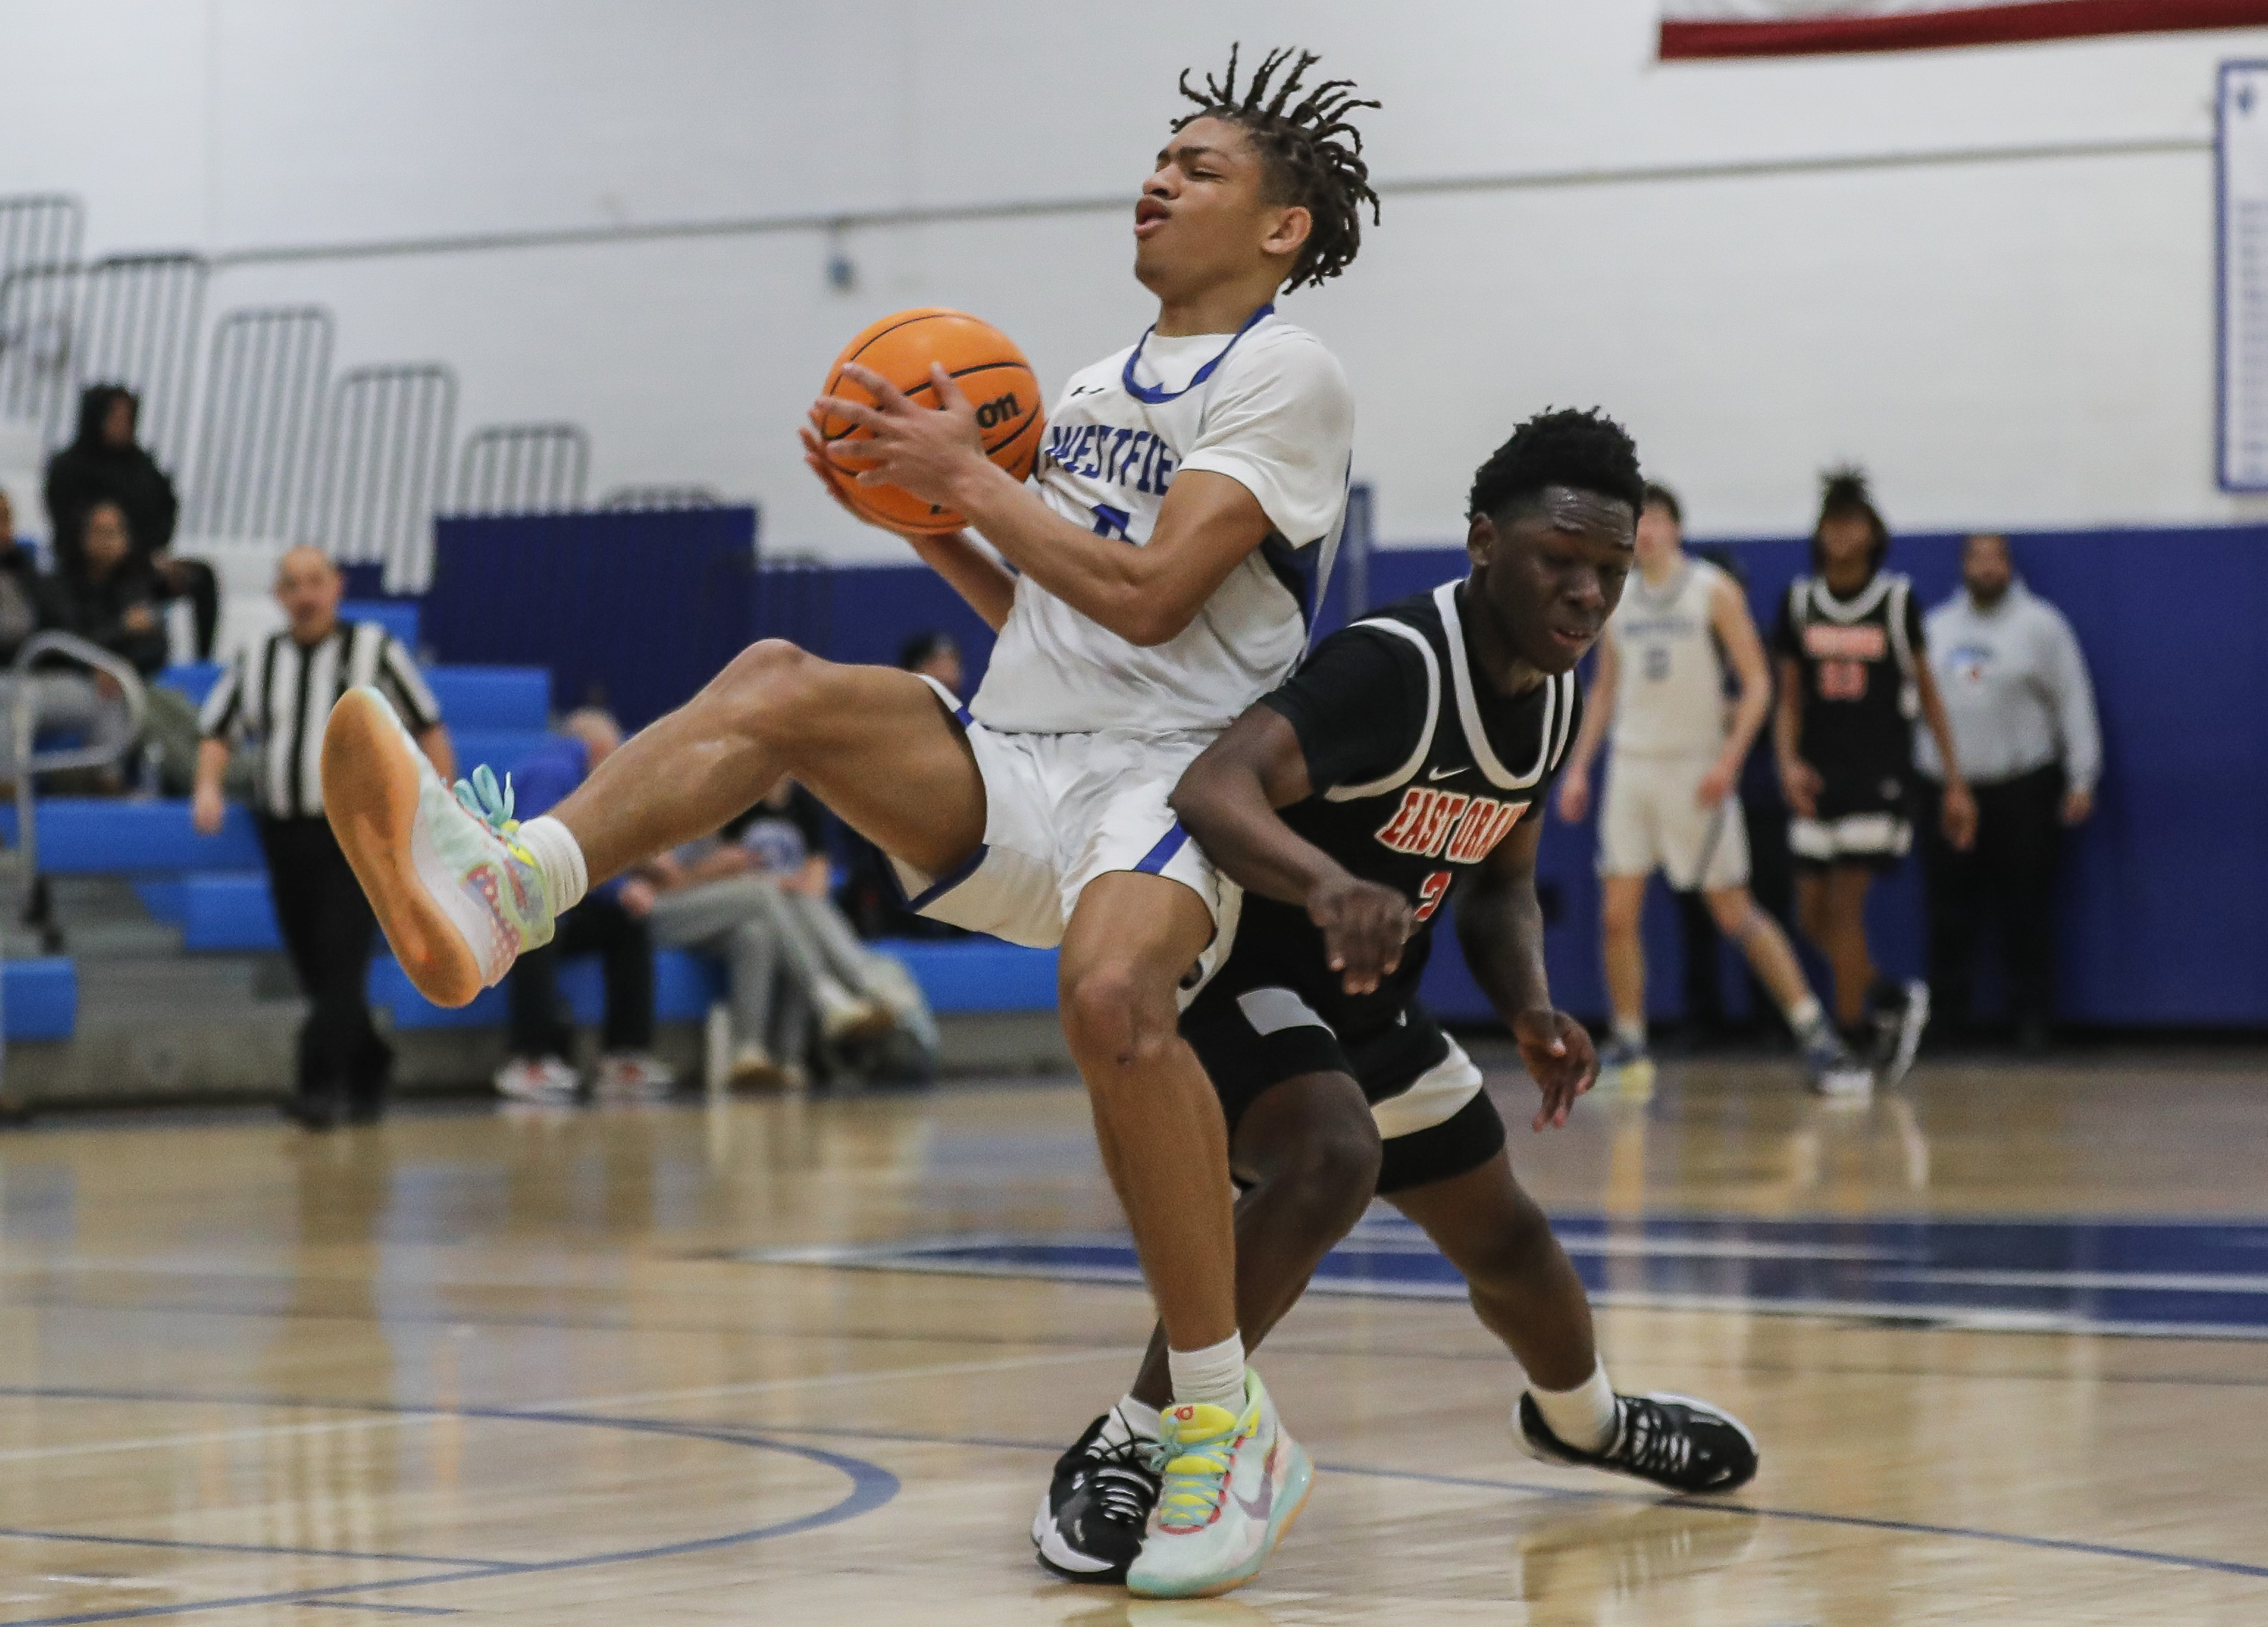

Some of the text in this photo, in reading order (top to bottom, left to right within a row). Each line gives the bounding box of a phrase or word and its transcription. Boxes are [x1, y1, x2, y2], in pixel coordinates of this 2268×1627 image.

[975, 392, 1021, 428] on
[1044, 425, 1181, 497] WESTFIE
[1375, 787, 1469, 858] EAST
